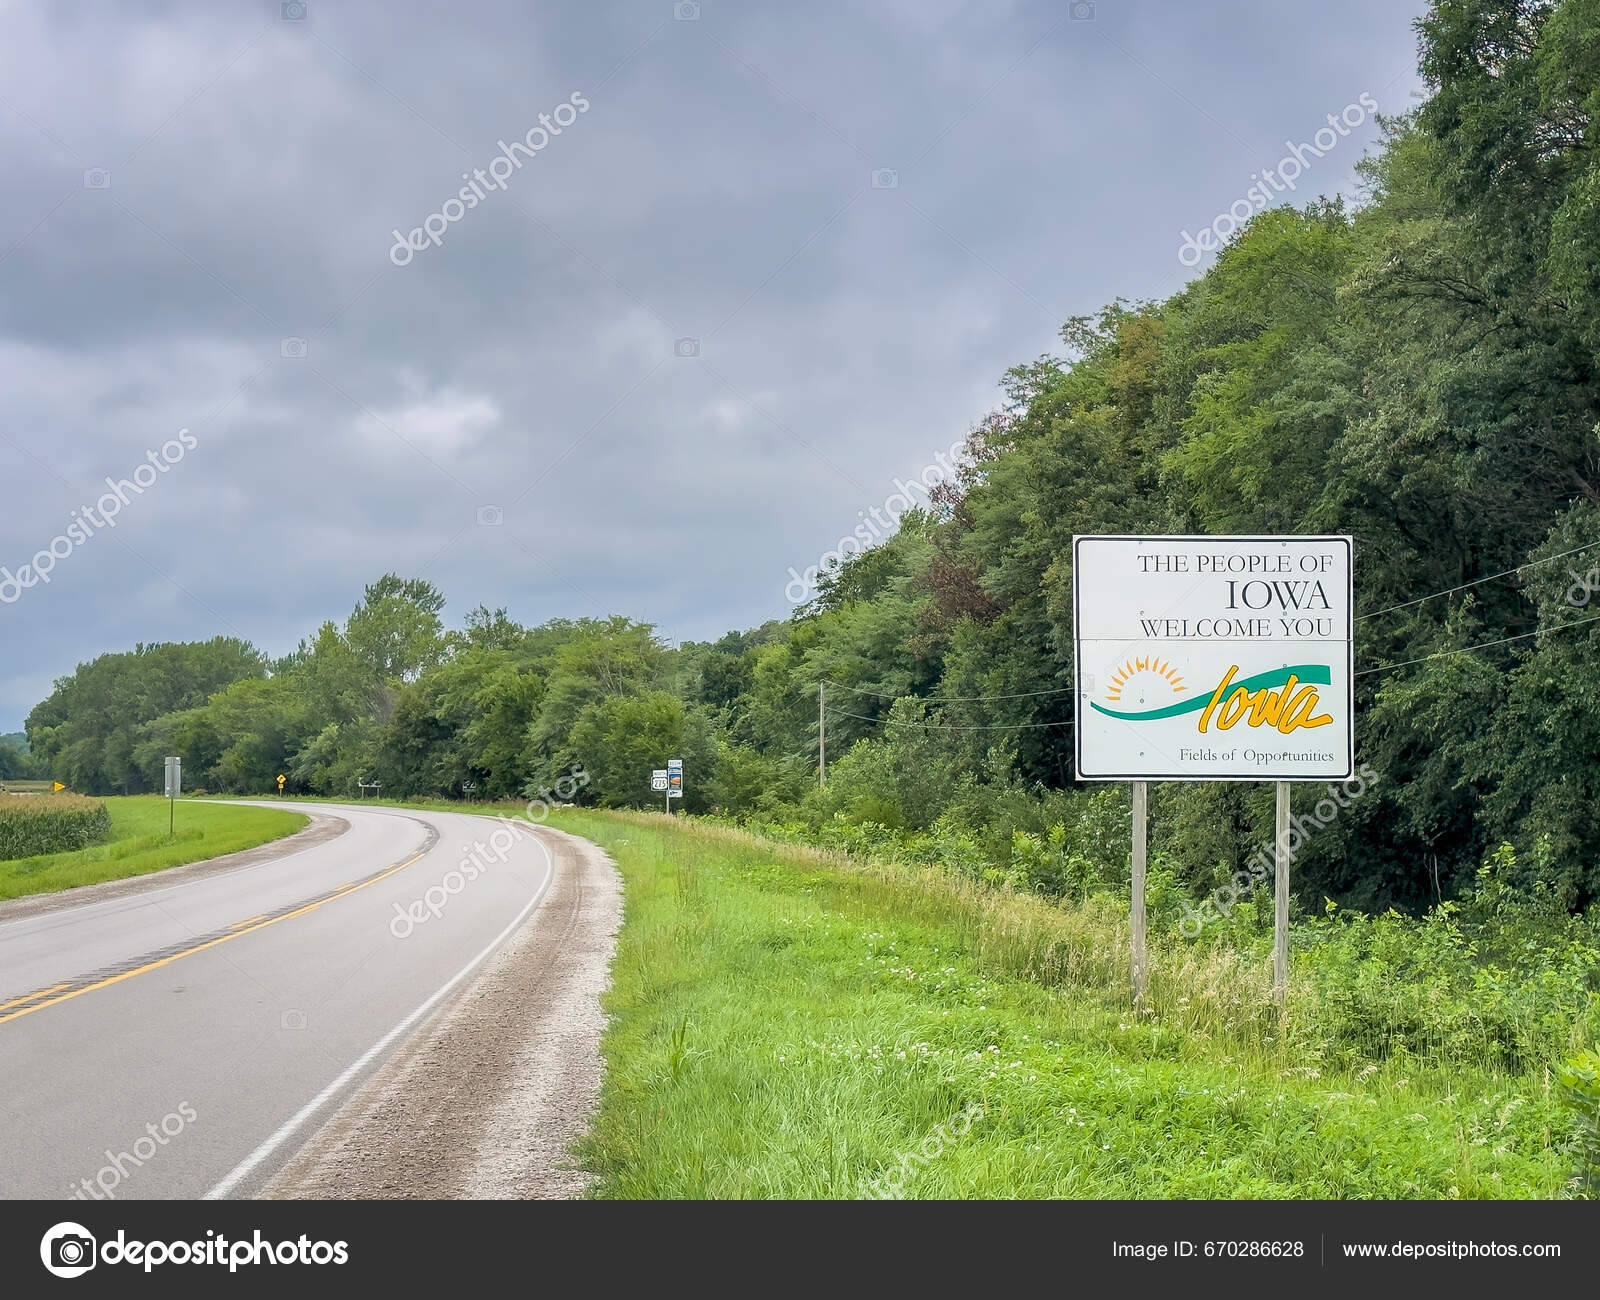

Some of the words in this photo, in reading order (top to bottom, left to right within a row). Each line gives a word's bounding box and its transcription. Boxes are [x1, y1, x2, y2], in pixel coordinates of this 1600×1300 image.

[1137, 555, 1189, 573] THE
[1196, 555, 1292, 573] PEOPLE
[1299, 555, 1334, 573] OF
[1225, 579, 1333, 610] IOWA
[1140, 618, 1272, 637] WELCOME
[1279, 618, 1332, 637] YOU
[1198, 664, 1334, 735] Iowa
[1180, 748, 1218, 762] Fields
[1221, 748, 1237, 762] of
[1243, 748, 1334, 765] Opportunities
